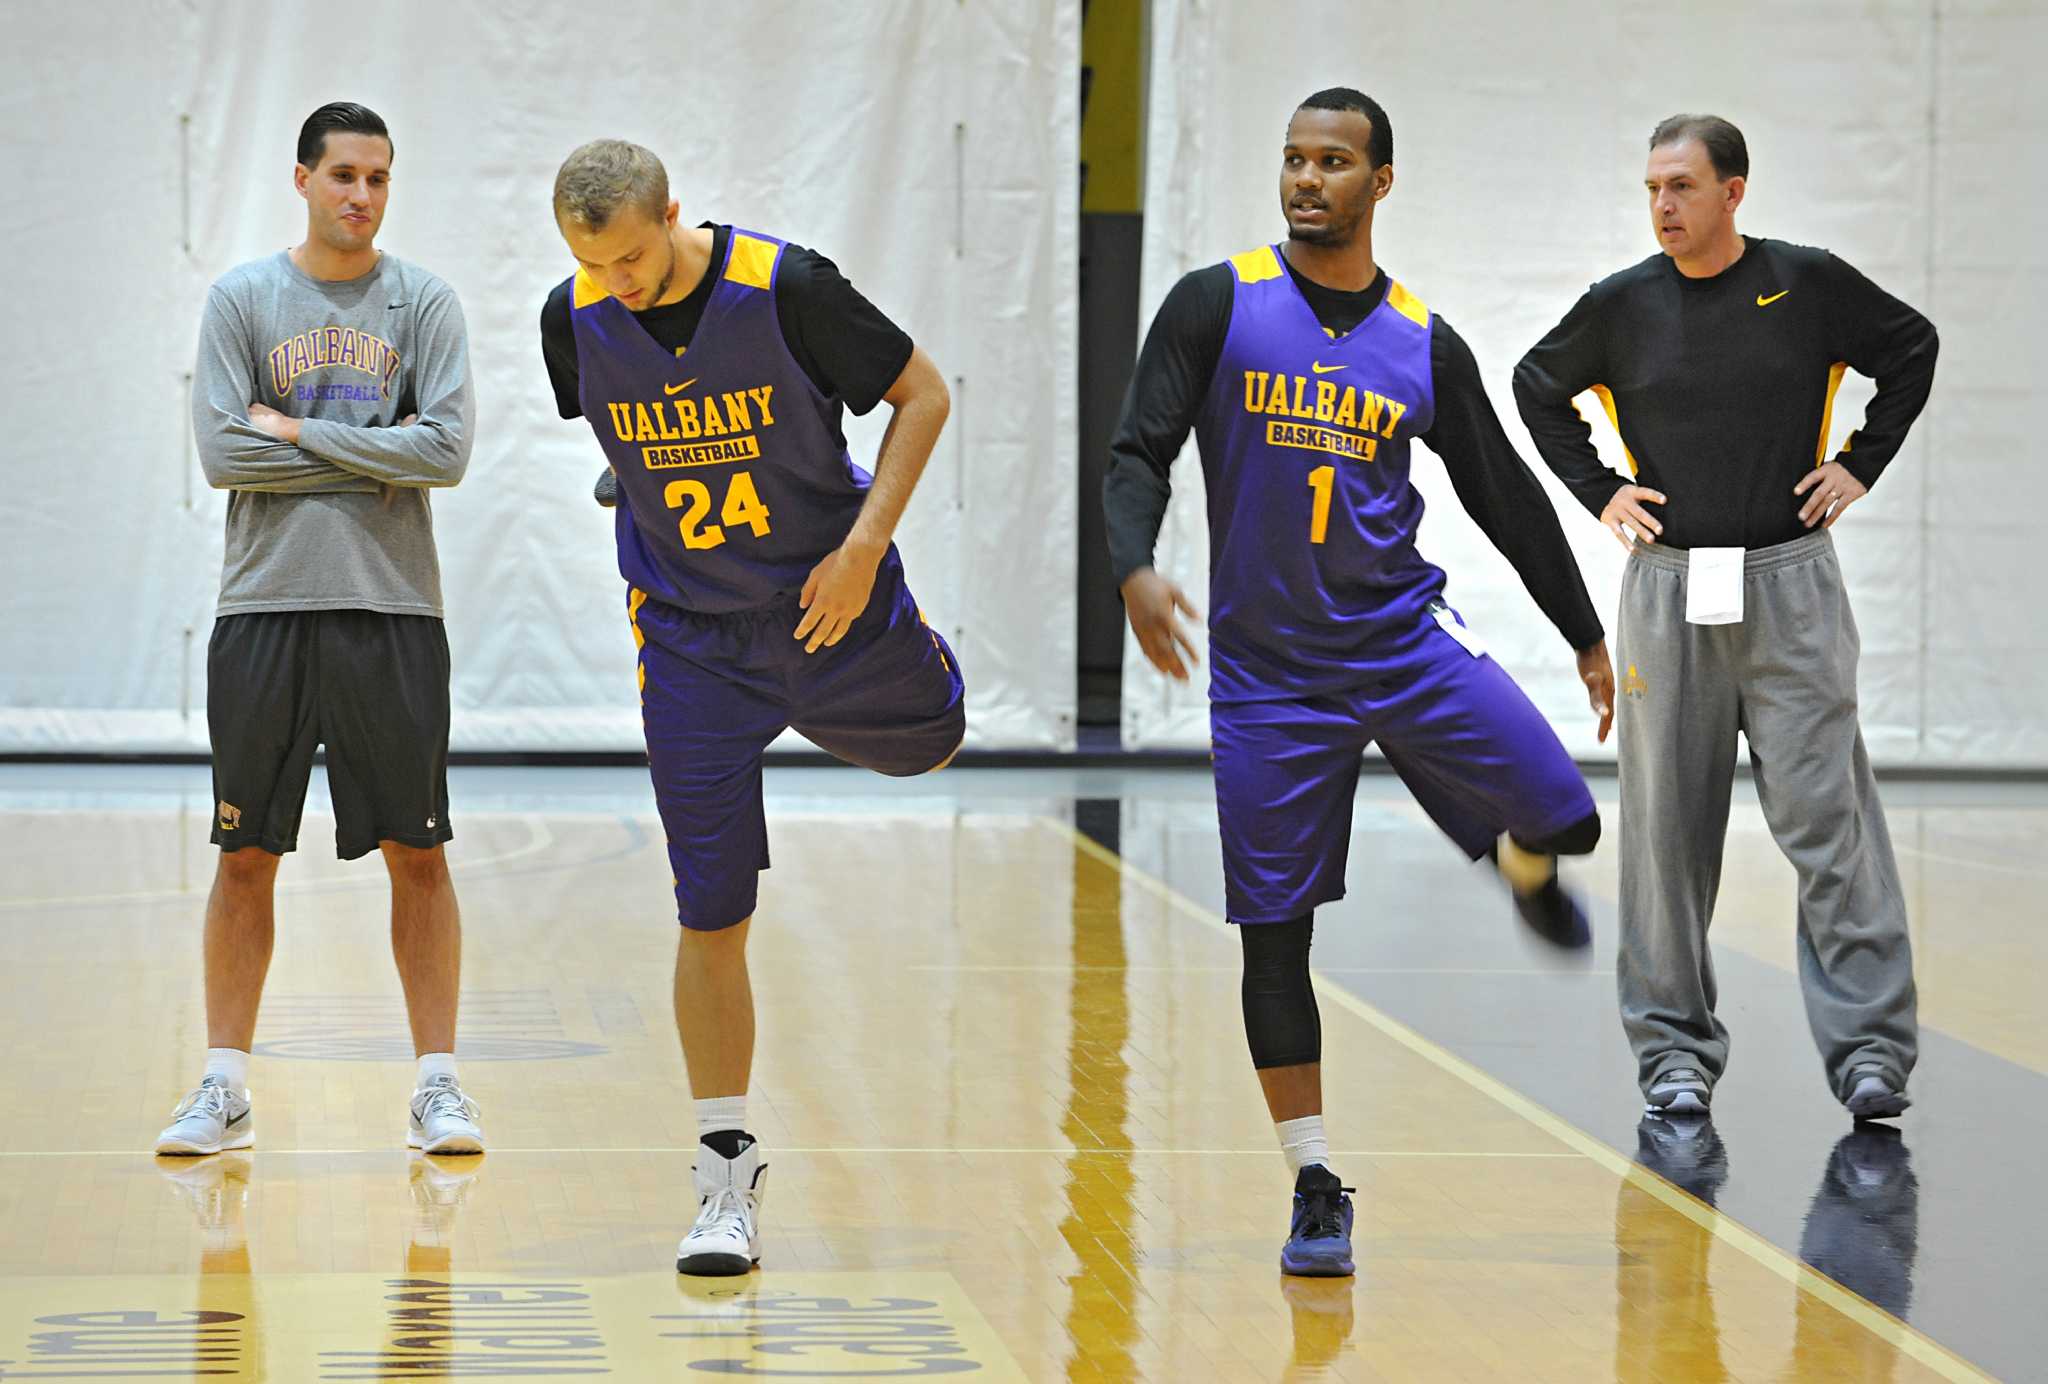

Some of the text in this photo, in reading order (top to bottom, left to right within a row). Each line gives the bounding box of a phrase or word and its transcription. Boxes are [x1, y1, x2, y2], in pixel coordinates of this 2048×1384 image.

[269, 326, 401, 400] UALBANY
[296, 383, 381, 401] BASKETBALL
[607, 385, 775, 442] UALBANY
[1244, 370, 1408, 440] UALBANY
[1272, 424, 1370, 457] BASKETBALL
[649, 440, 754, 467] BASKETBALL
[663, 471, 772, 550] 24
[1307, 465, 1336, 544] 1
[317, 1278, 612, 1380] Warner
[649, 1297, 983, 1377] Cable
